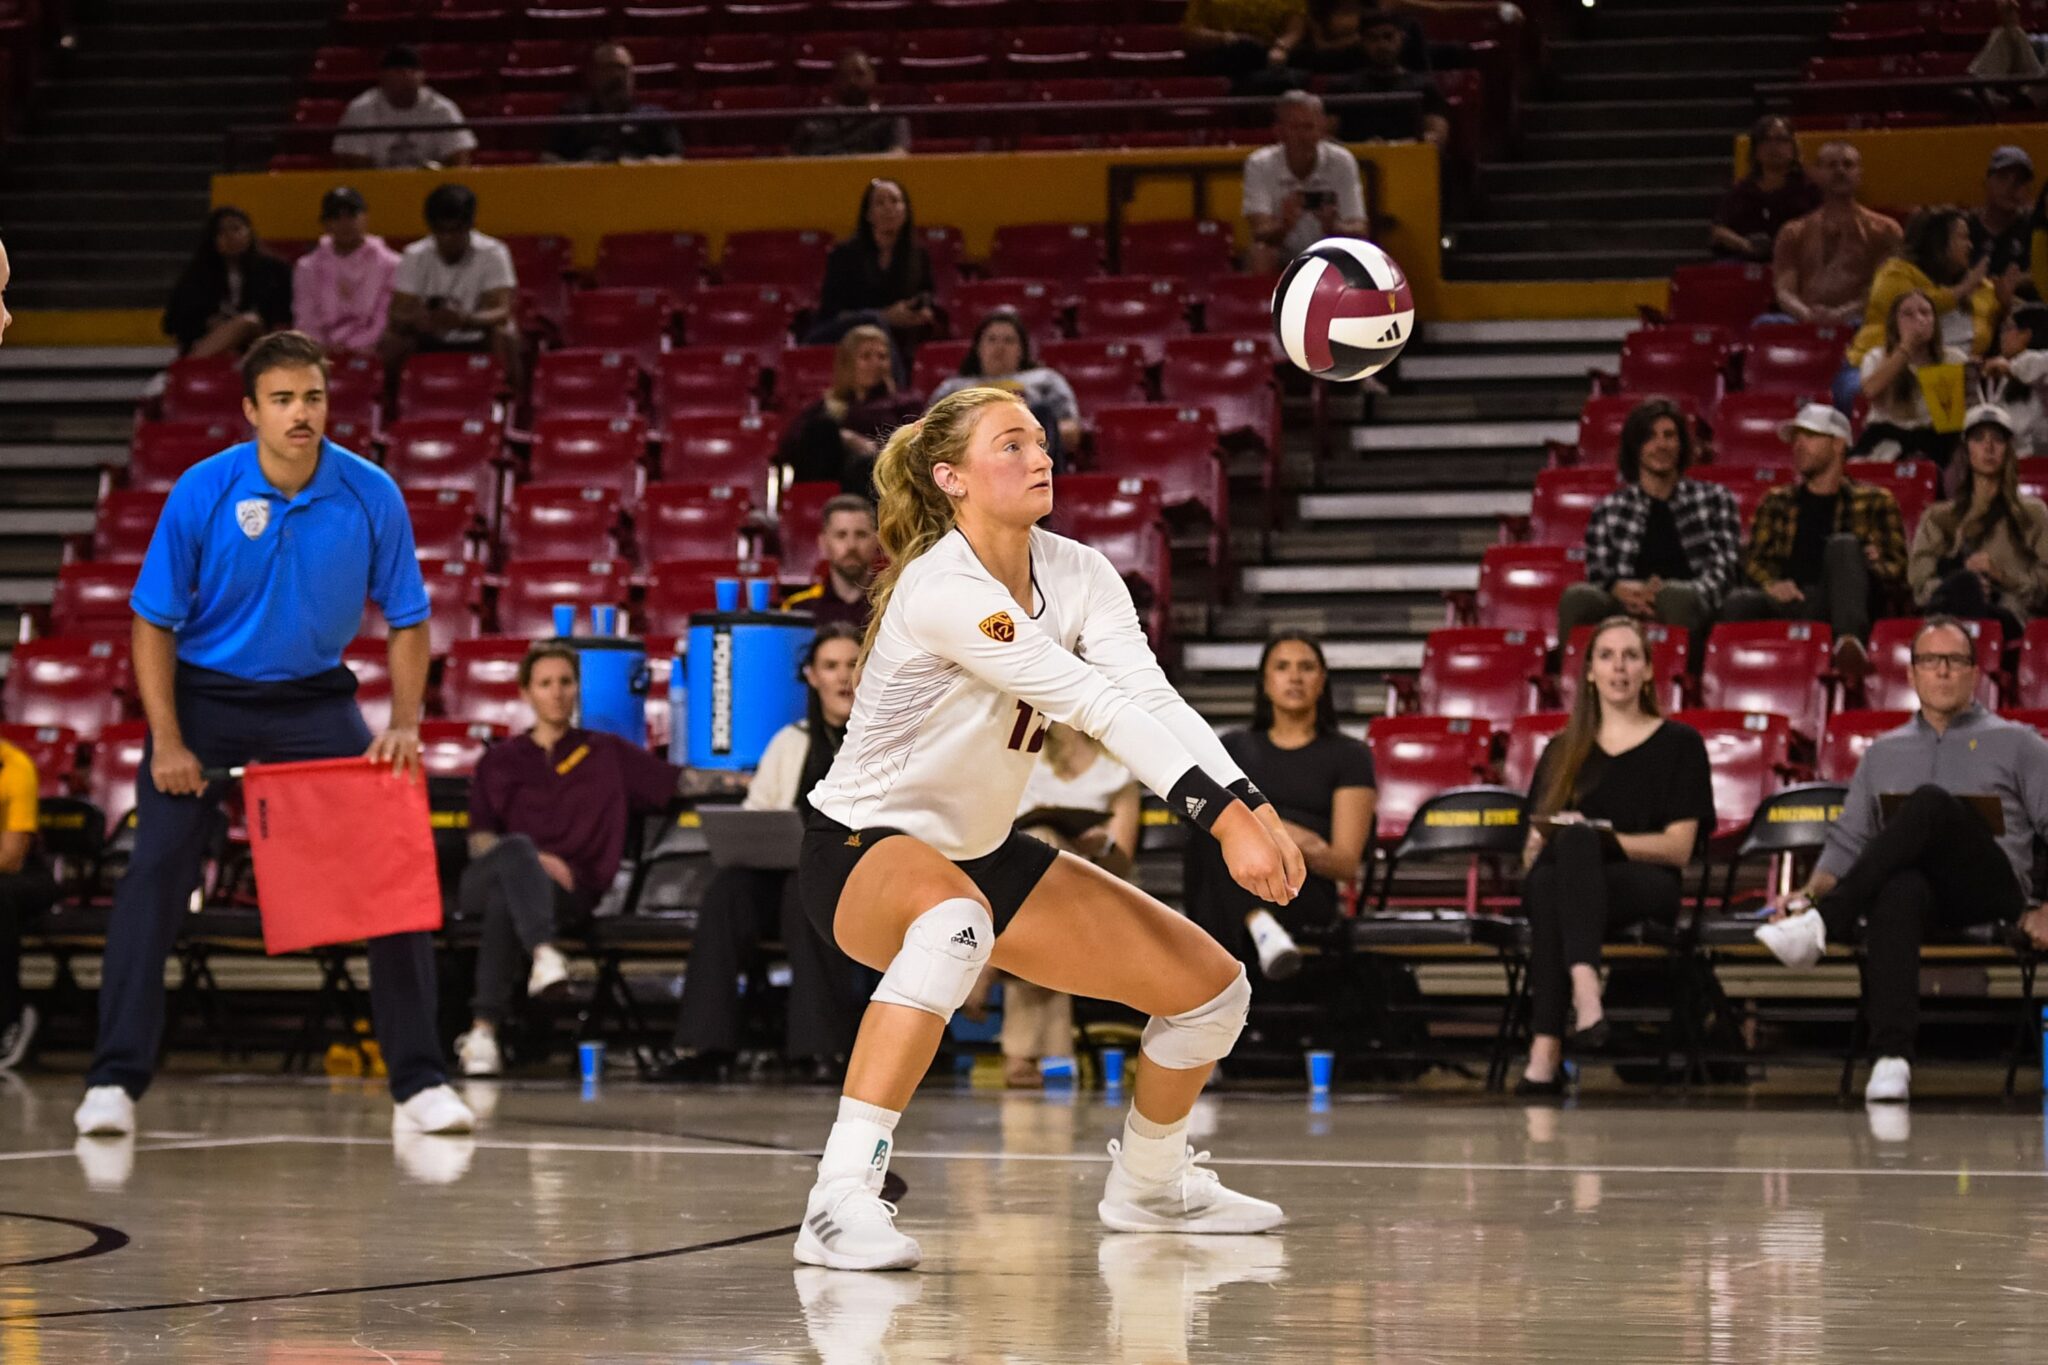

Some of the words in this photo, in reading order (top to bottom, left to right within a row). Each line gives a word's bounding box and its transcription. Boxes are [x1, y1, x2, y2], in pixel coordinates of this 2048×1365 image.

[980, 612, 1012, 637] PAC
[995, 626, 1013, 641] 12
[950, 936, 979, 949] adidas
